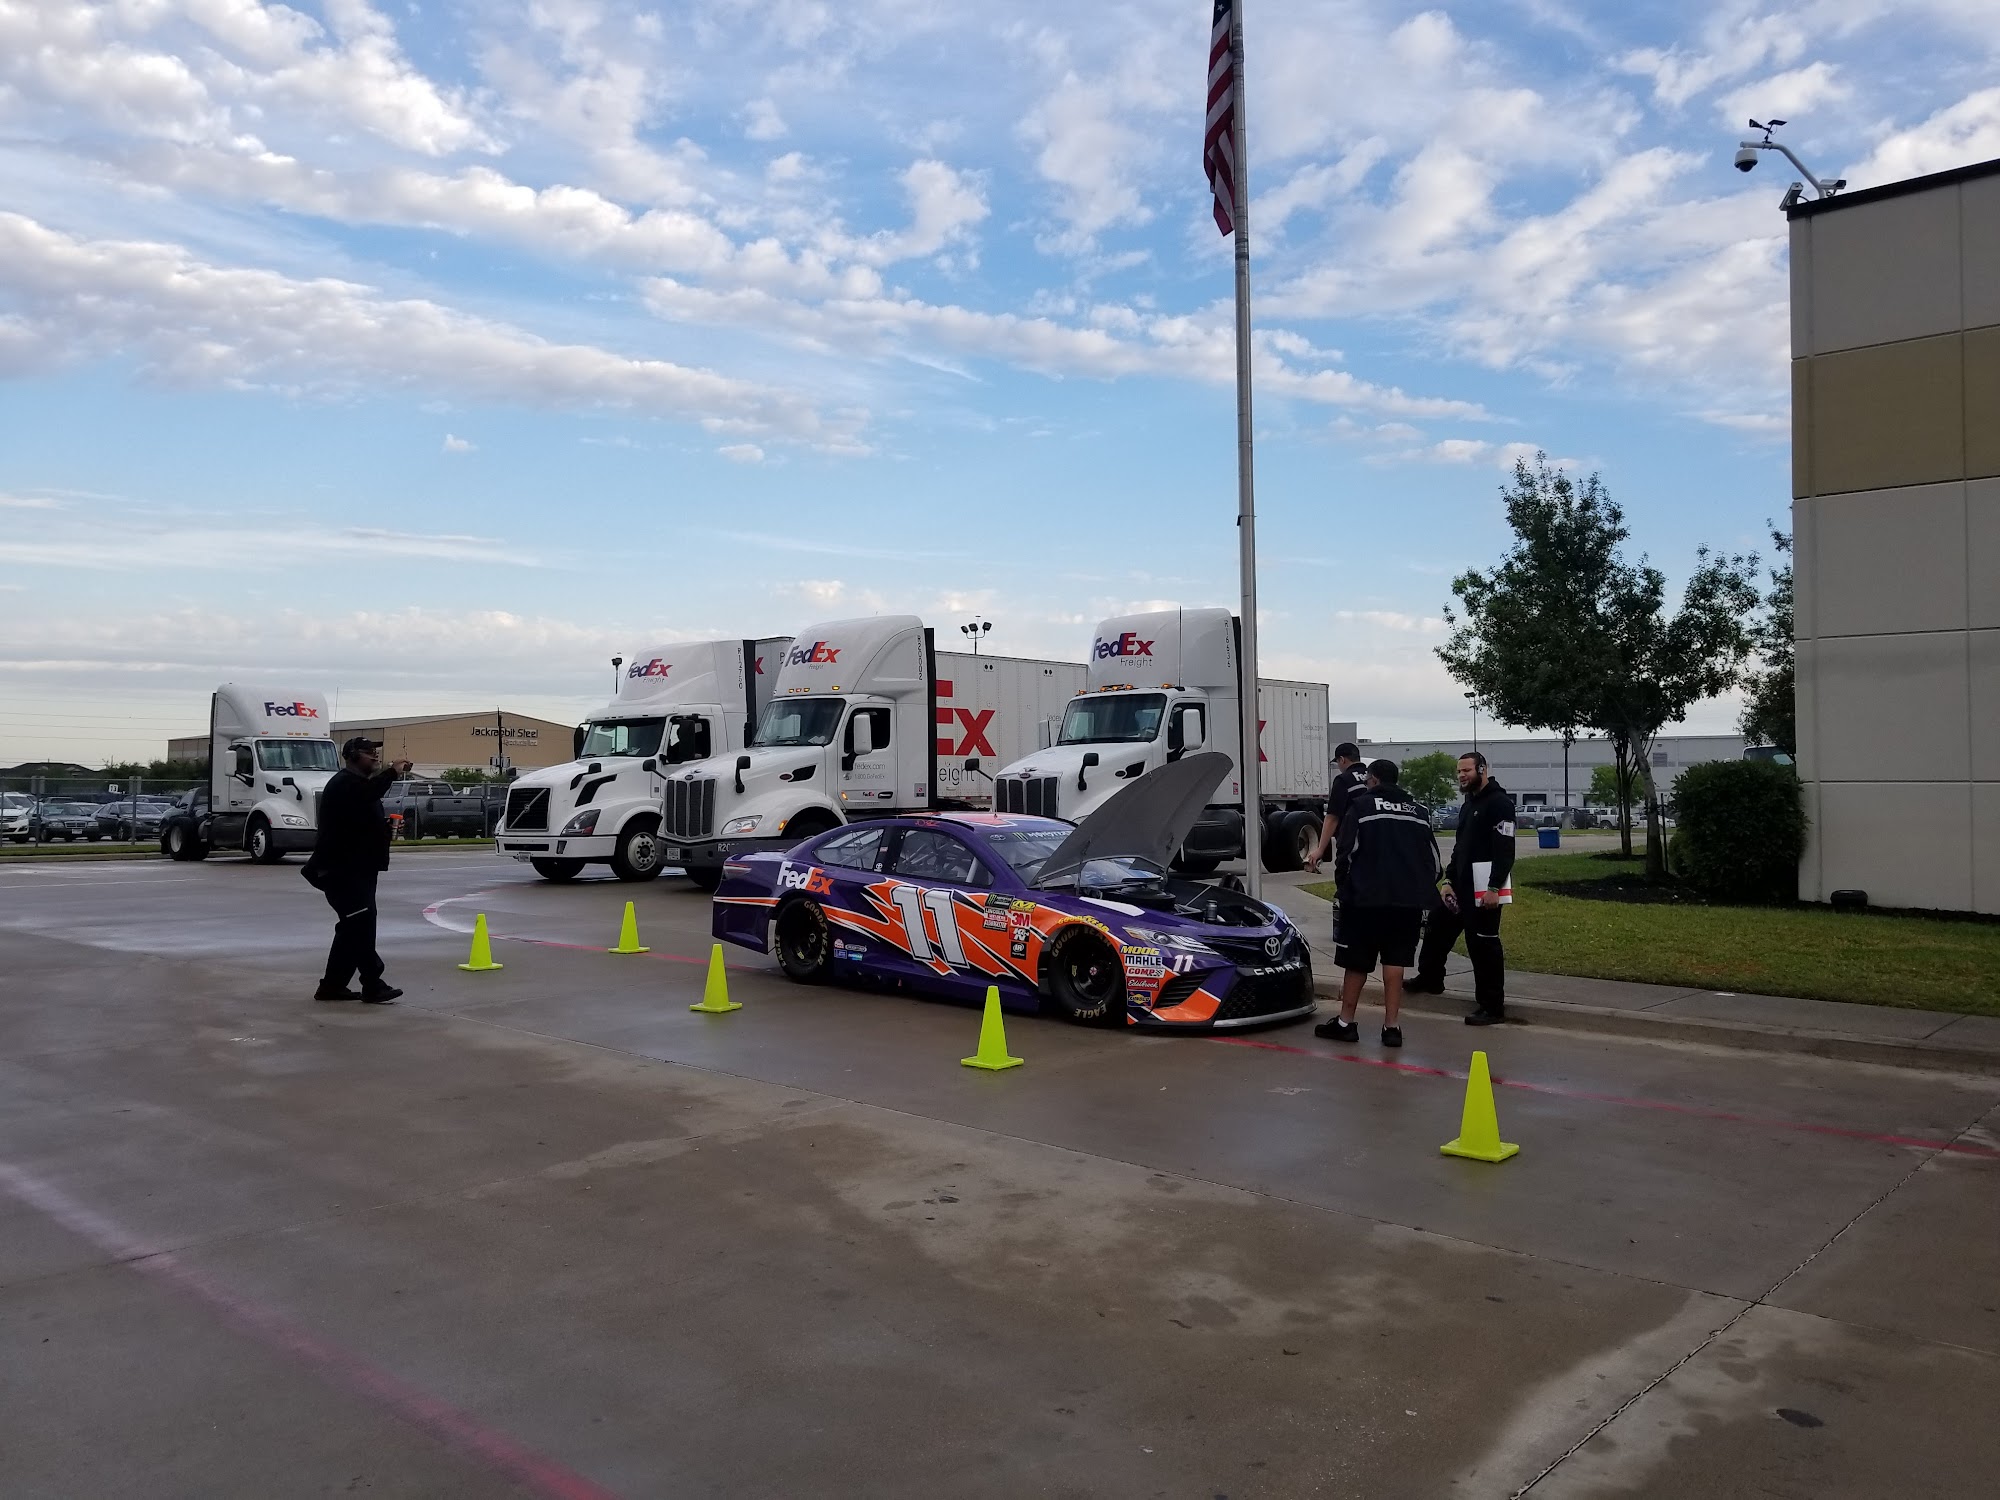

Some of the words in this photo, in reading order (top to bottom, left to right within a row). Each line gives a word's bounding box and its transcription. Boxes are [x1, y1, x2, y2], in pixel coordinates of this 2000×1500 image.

[784, 640, 842, 667] FedEx
[1092, 632, 1155, 662] FedEx
[625, 658, 673, 681] FedEx
[1120, 657, 1153, 668] Freight
[643, 676, 665, 684] Freight
[263, 701, 319, 719] FedEx
[471, 726, 515, 737] Jackrabbit
[517, 728, 538, 738] Steel
[854, 762, 886, 771] fedex.com
[1374, 797, 1418, 815] FedEx
[776, 861, 835, 896] FedEx
[889, 885, 970, 969] 11
[1012, 912, 1030, 927] 3M
[1120, 945, 1161, 956] MOOG
[1125, 955, 1163, 966] MAHLE
[1173, 954, 1194, 973] 11
[1128, 967, 1156, 976] COMP
[1073, 1003, 1108, 1019] EAGLE
